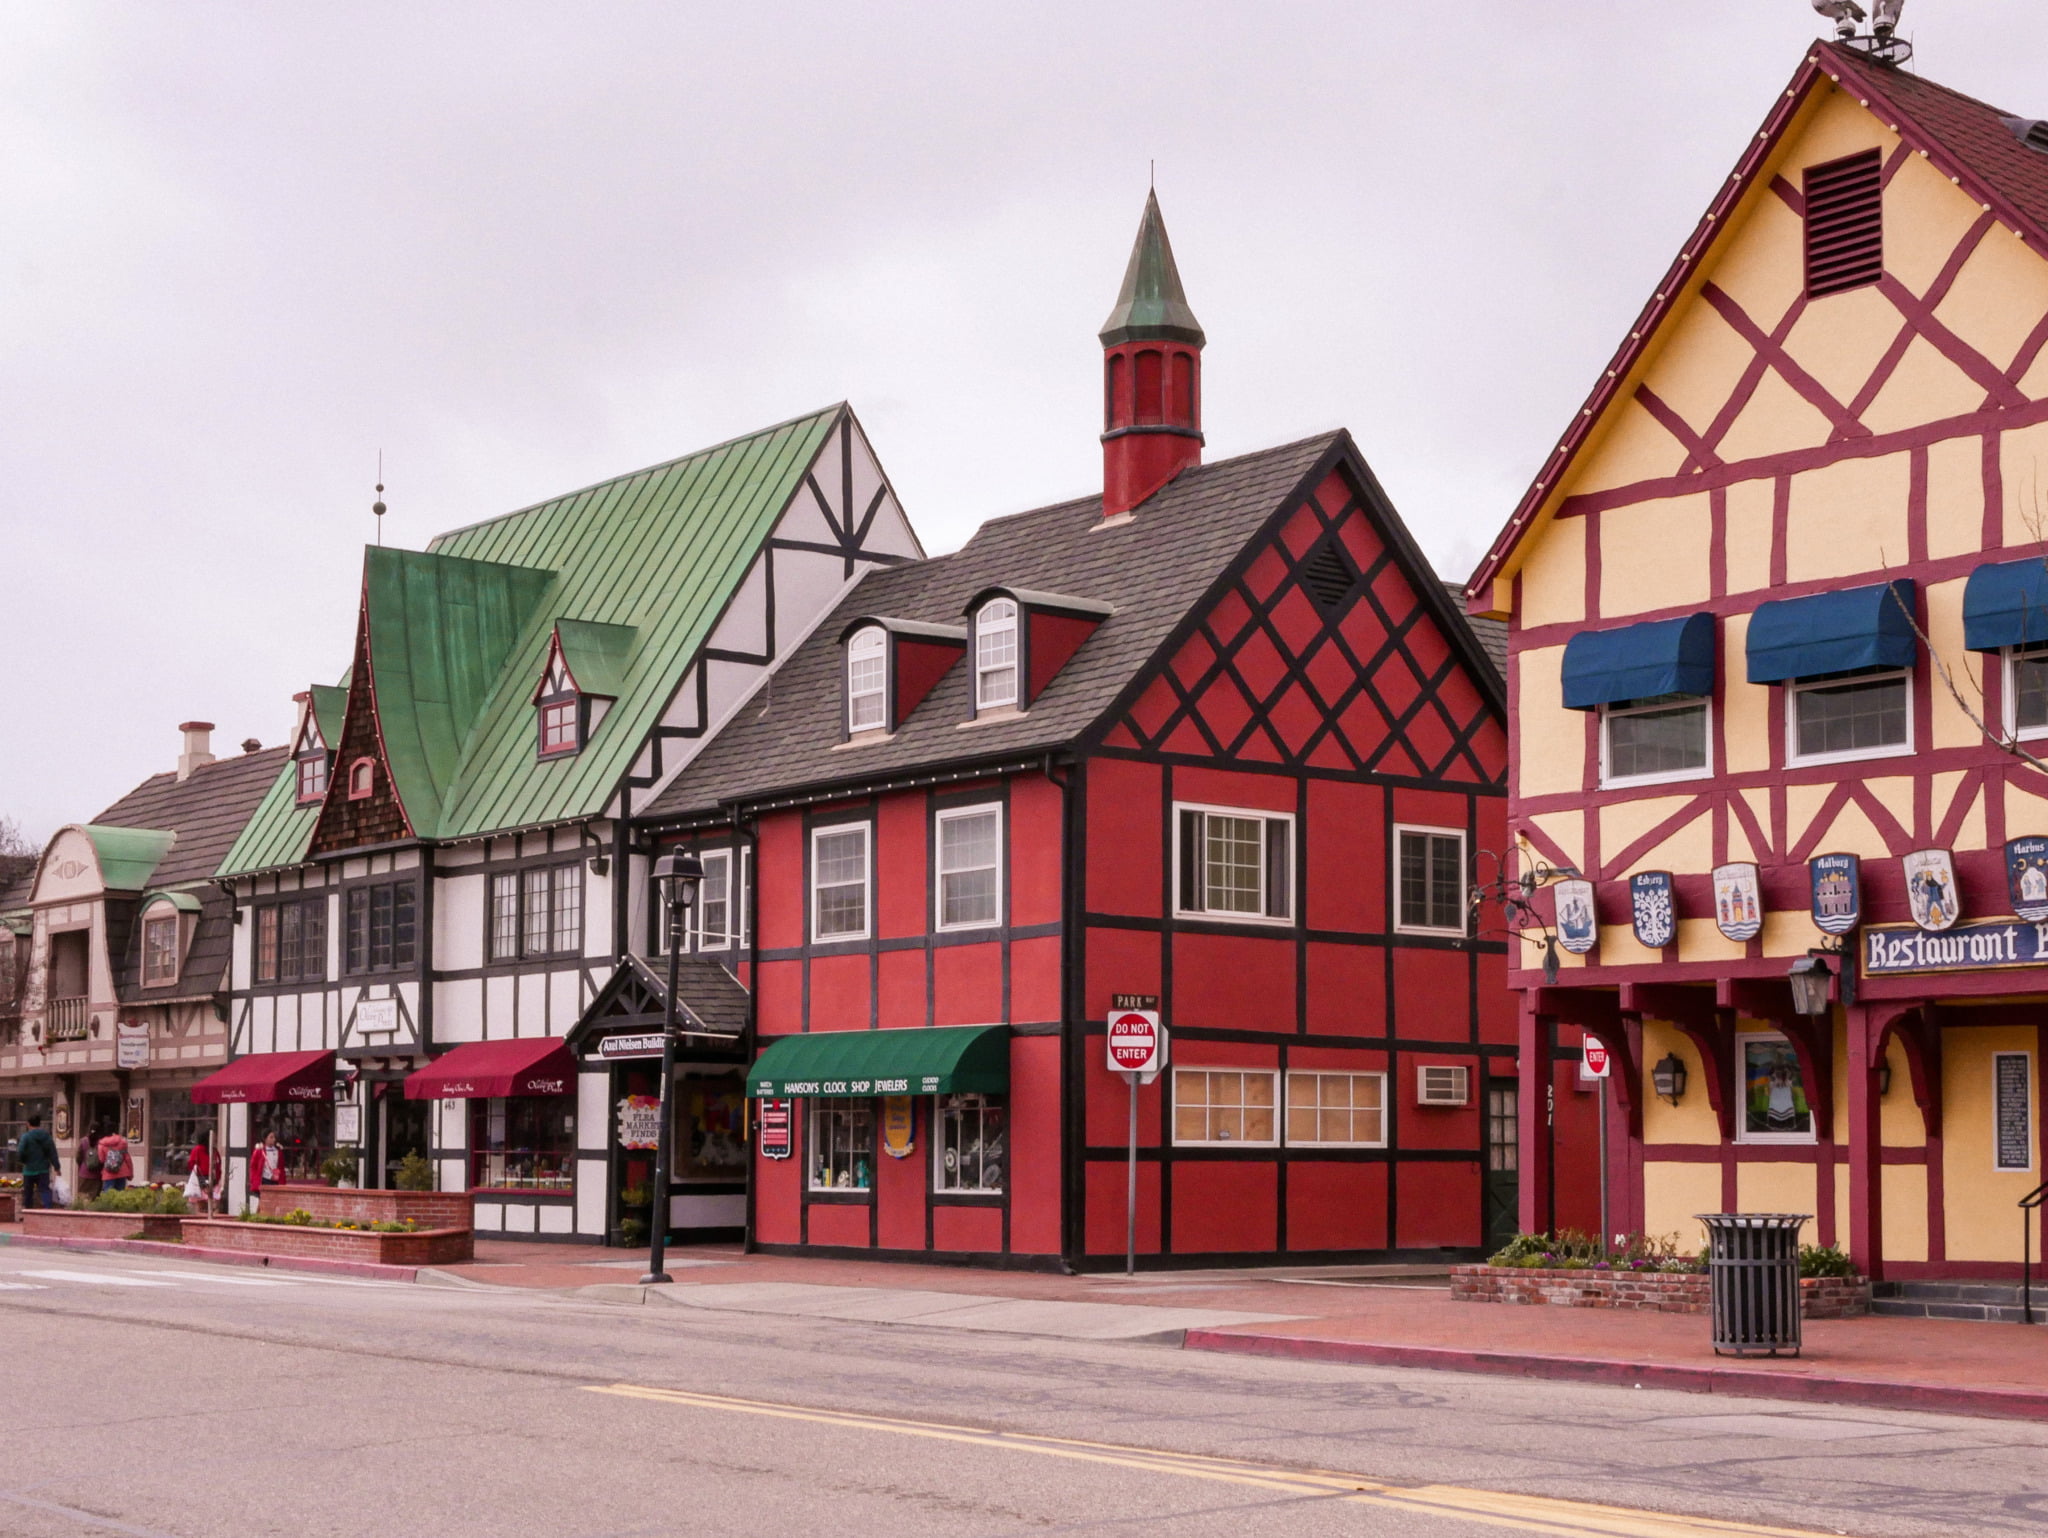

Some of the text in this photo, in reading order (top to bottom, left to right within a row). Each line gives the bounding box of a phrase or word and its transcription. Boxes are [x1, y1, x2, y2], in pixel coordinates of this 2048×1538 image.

[1868, 924, 2018, 968] Restaurant
[1117, 994, 1143, 1008] PARK
[1115, 1023, 1150, 1034] DO NOT
[619, 1038, 642, 1051] Nielsen
[1116, 1048, 1147, 1060] ENTER
[1589, 1051, 1605, 1062] ENTER
[784, 1079, 908, 1094] HANSON'S CLOCK SHOP JEWELERS
[633, 1113, 655, 1121] FLEA
[630, 1129, 657, 1138] FINDS
